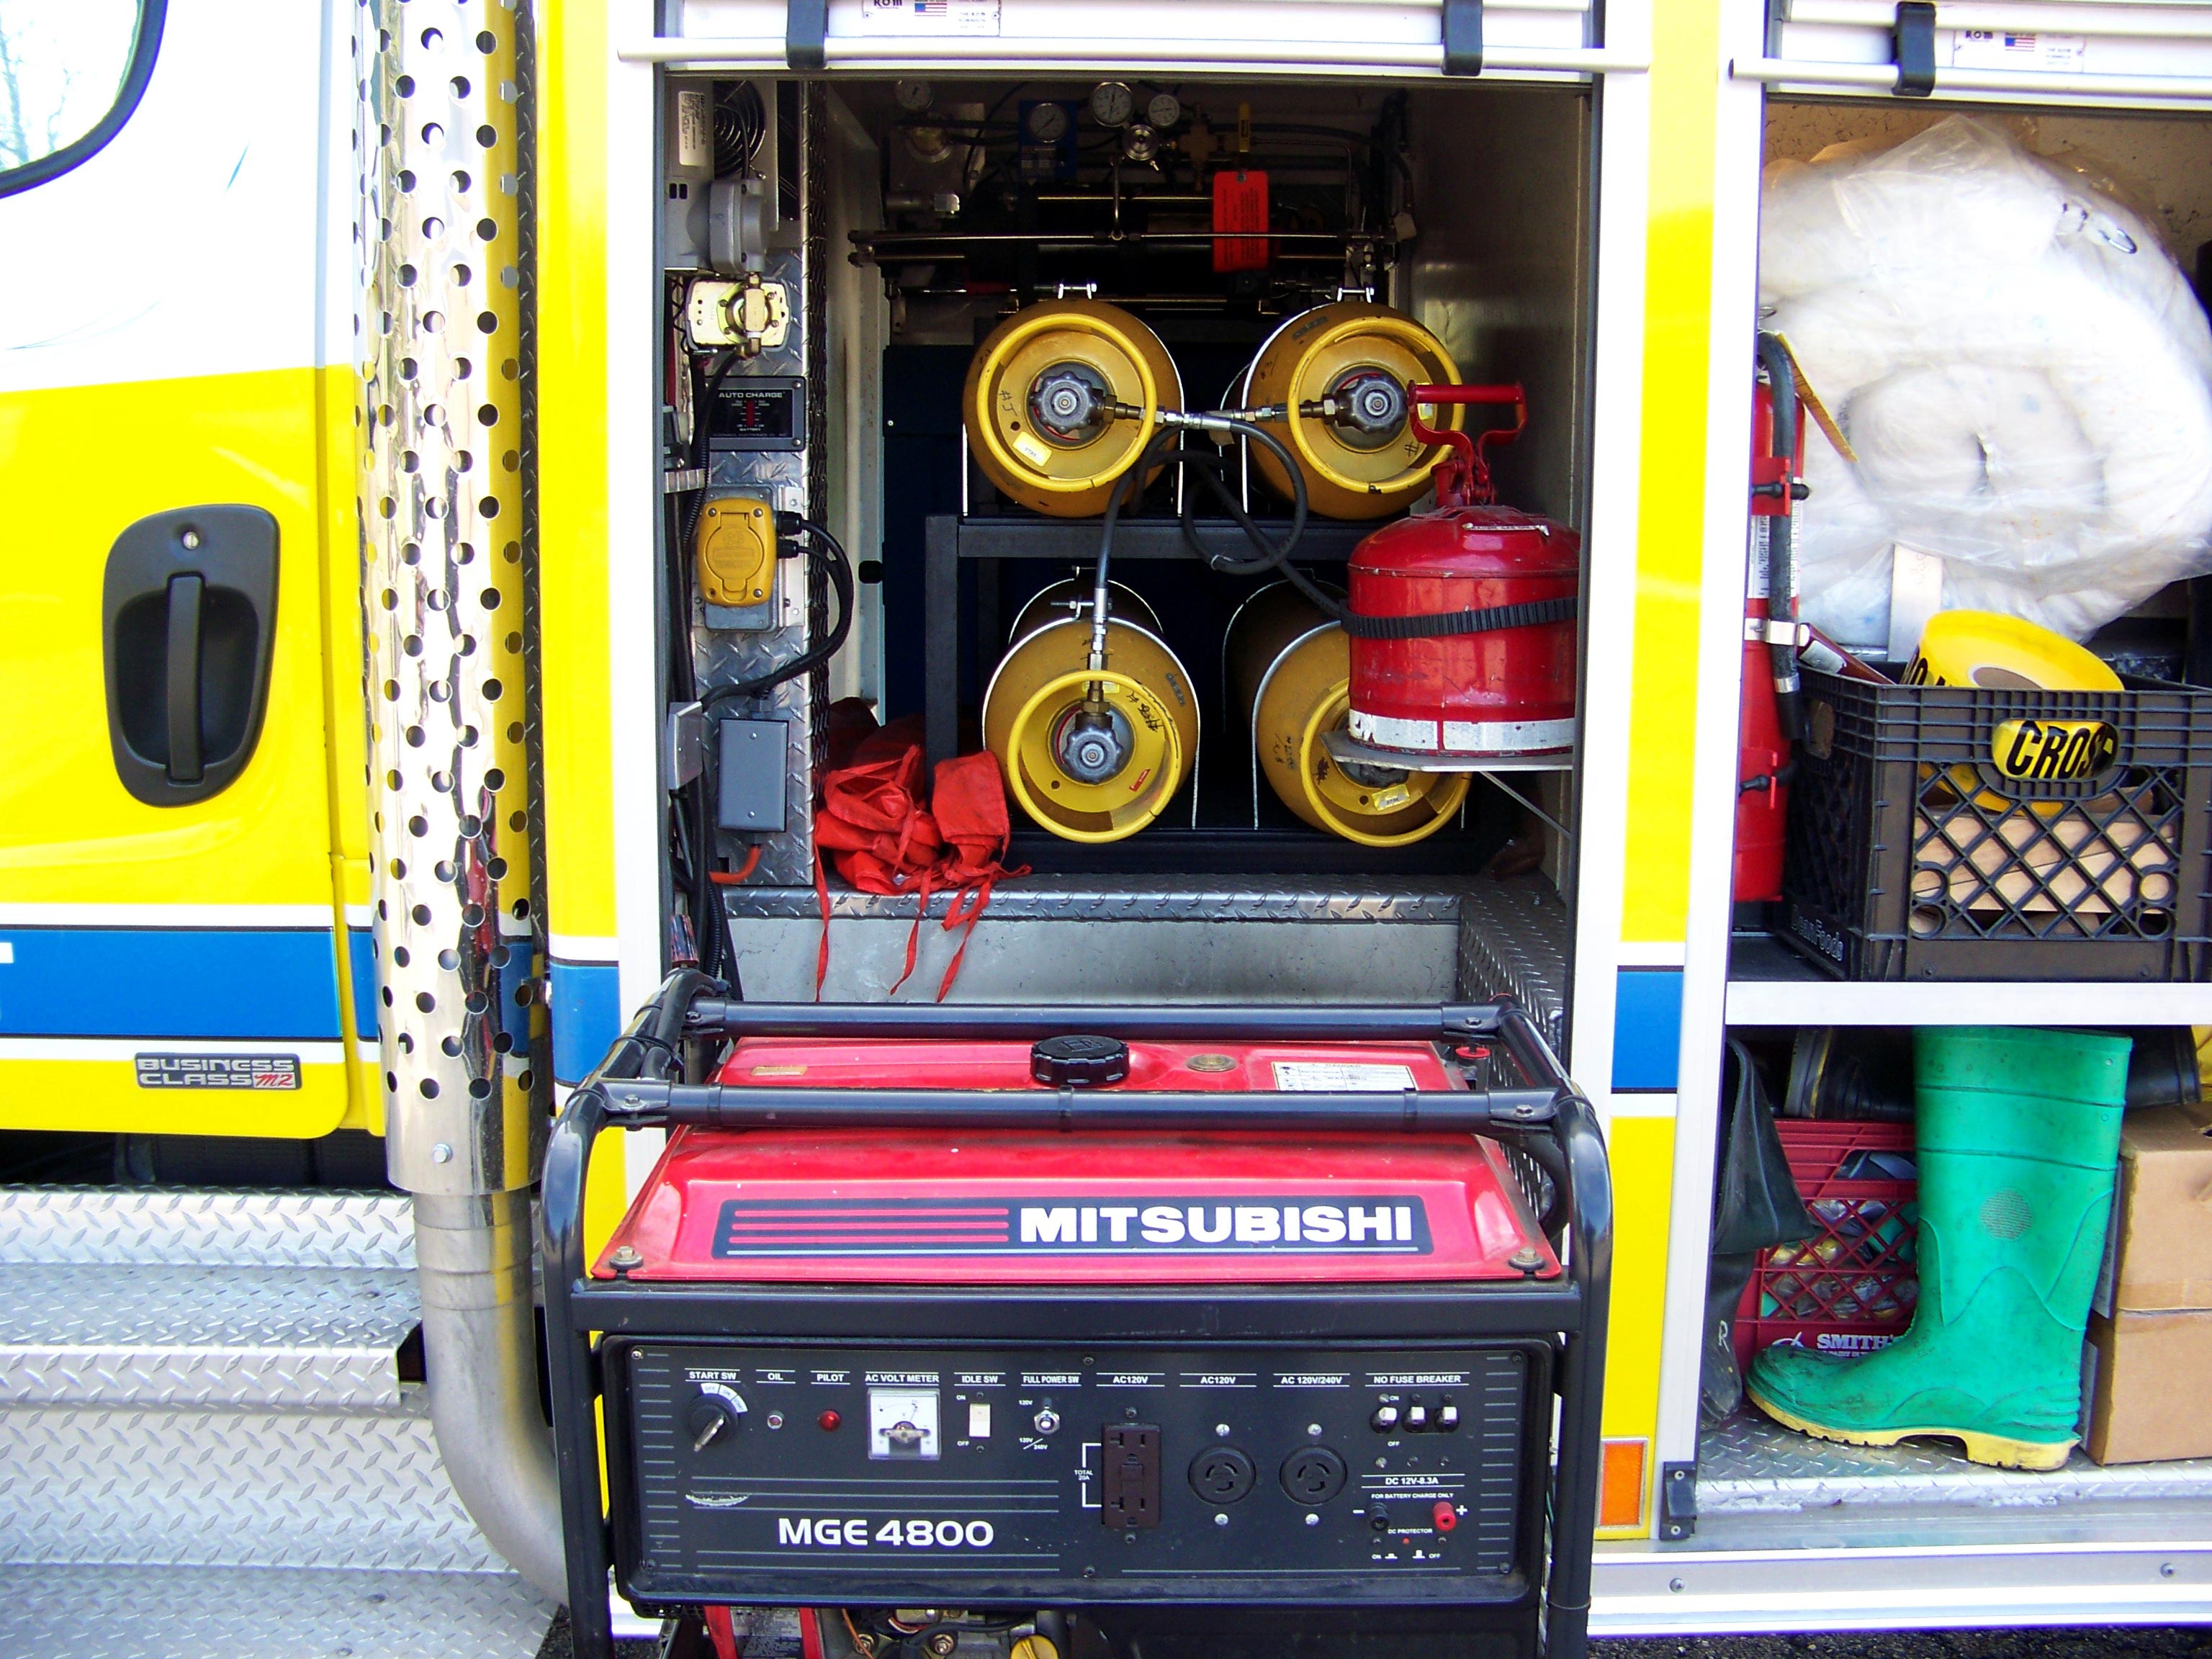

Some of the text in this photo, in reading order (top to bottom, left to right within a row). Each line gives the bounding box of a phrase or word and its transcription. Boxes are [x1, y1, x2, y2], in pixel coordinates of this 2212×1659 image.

[2006, 720, 2117, 779] CROS
[137, 1058, 295, 1071] BUSINESS
[140, 1074, 252, 1085] CLASS
[1020, 1206, 1413, 1243] MITSUBISHI
[721, 1372, 737, 1380] SW
[817, 1373, 845, 1382] PILOT
[778, 1518, 994, 1547] MGE 4800
